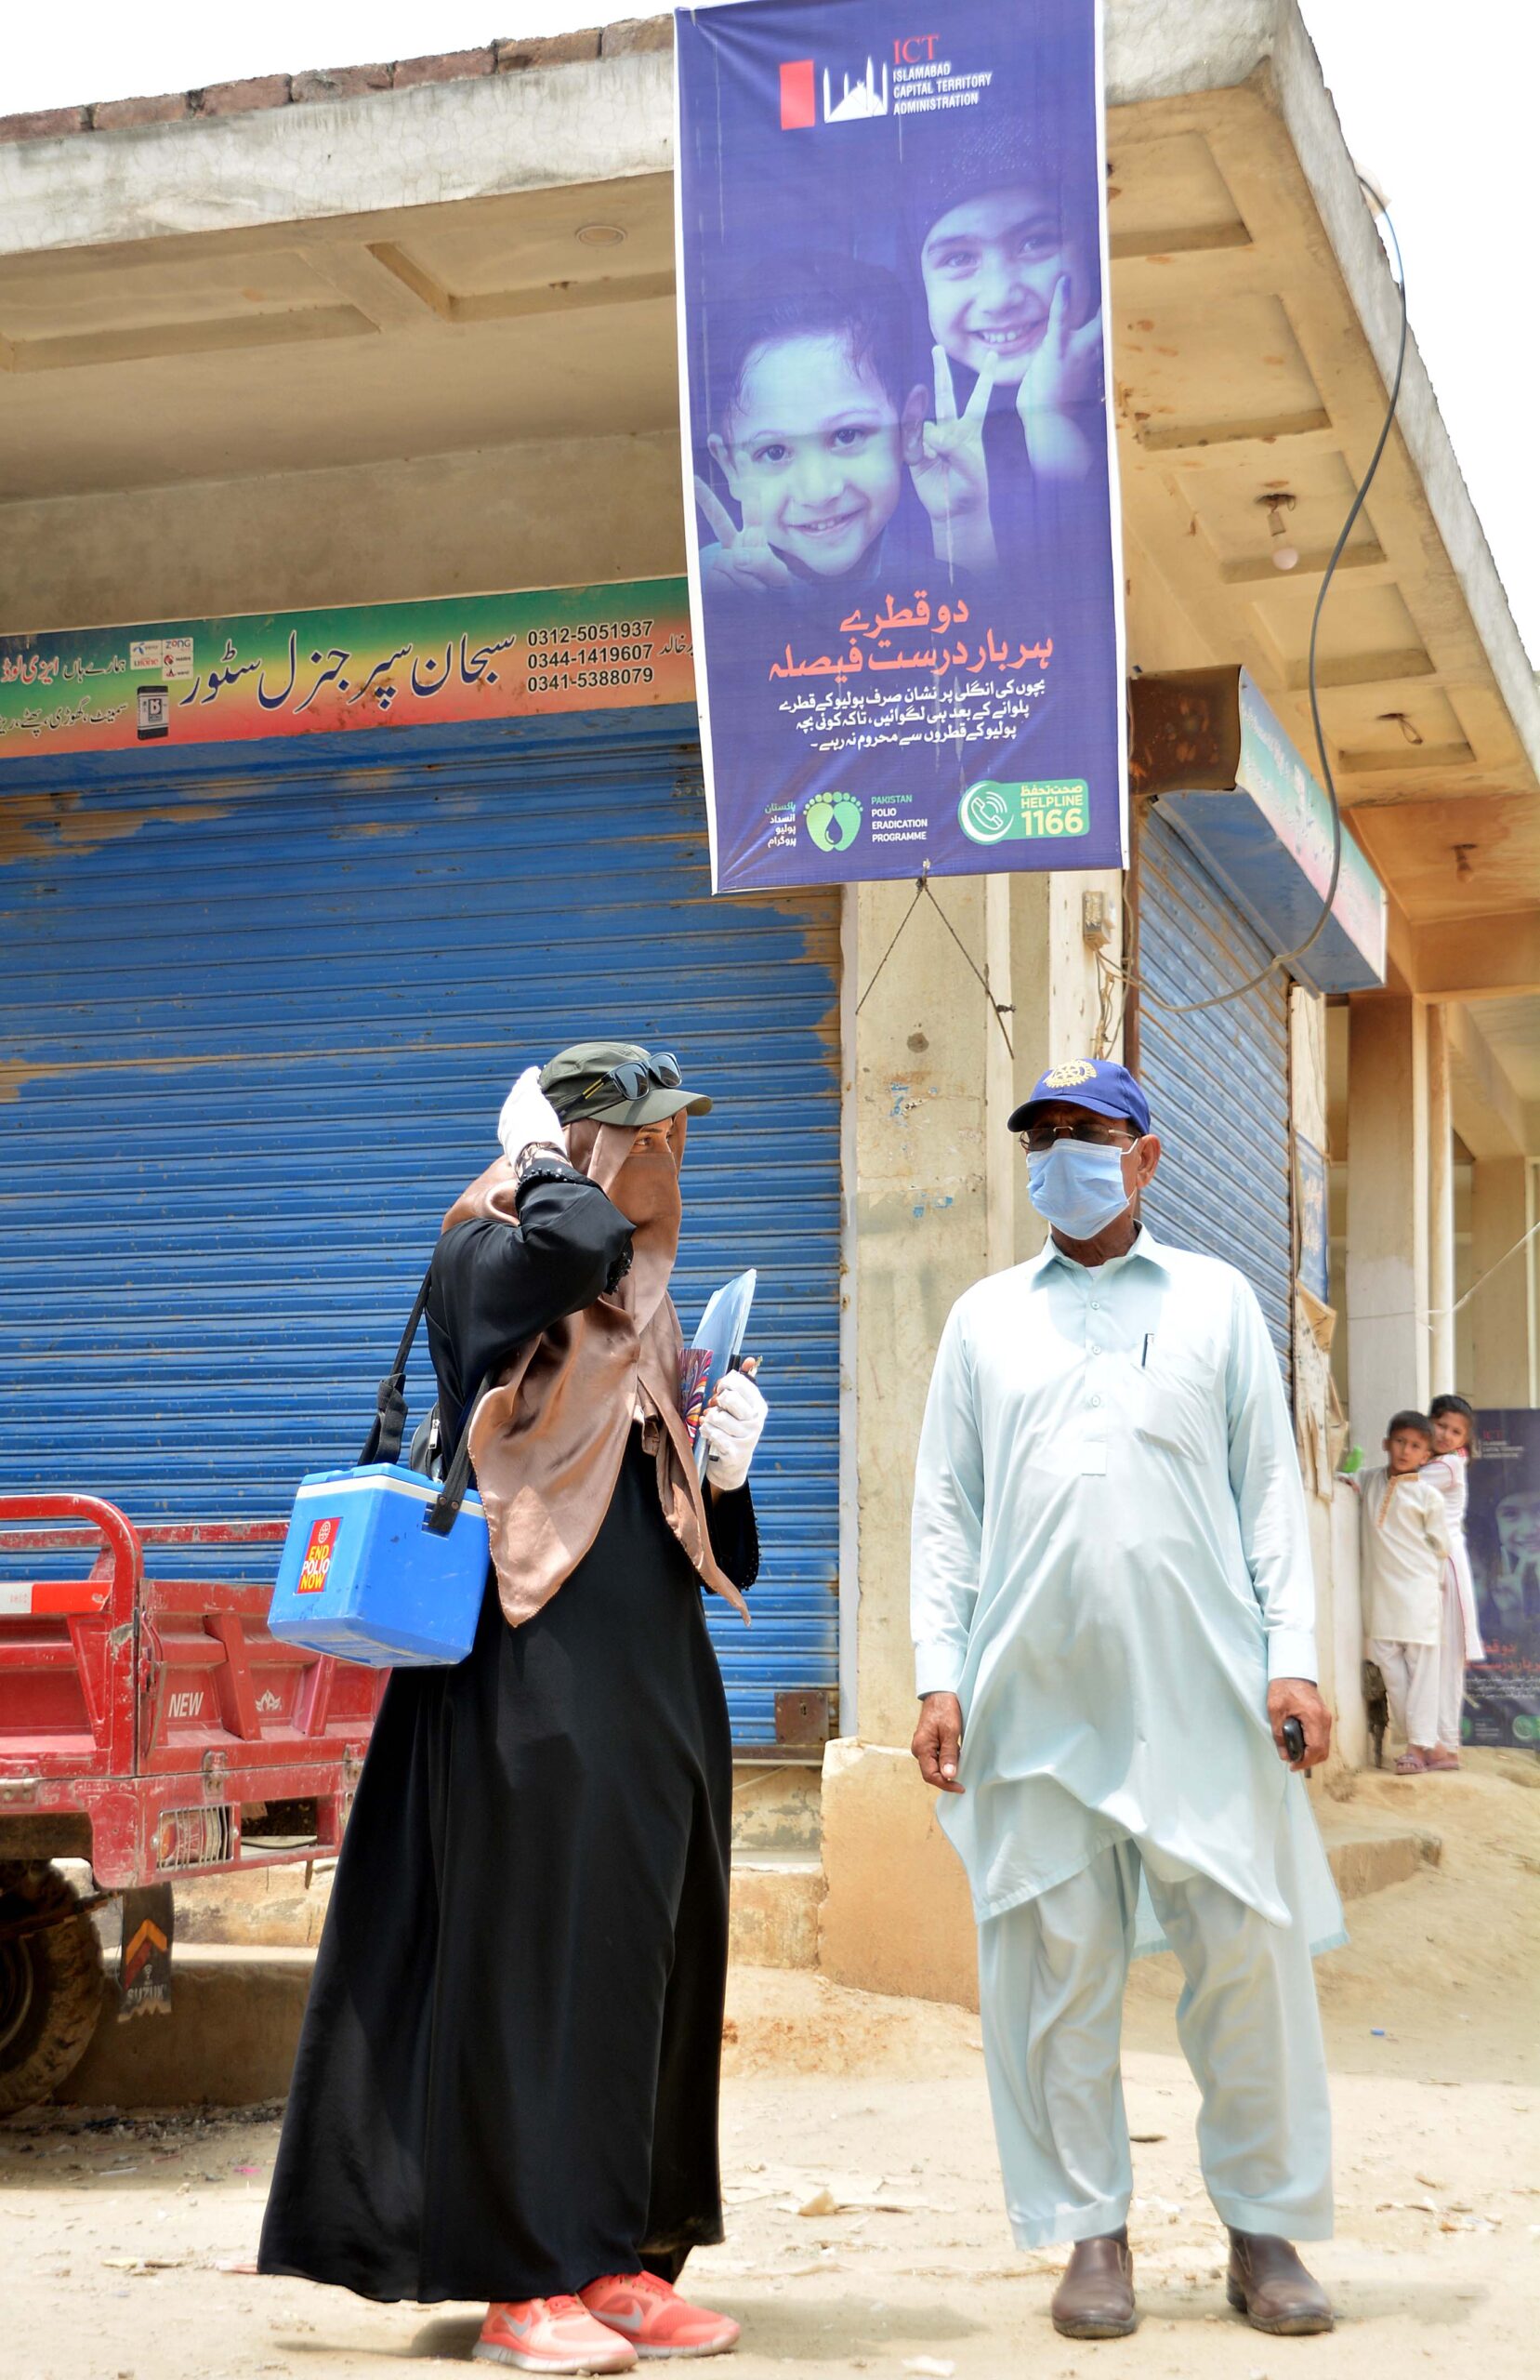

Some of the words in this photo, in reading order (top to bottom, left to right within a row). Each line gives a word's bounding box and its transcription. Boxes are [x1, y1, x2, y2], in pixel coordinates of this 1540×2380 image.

[893, 34, 941, 64] ICT
[893, 60, 951, 82] ISLAMABAD
[893, 81, 933, 99] CAPITAL
[937, 71, 993, 93] TERRITORY
[893, 90, 979, 115] ADMINISTRATION
[839, 589, 930, 640] قطرے
[930, 599, 969, 634] دو
[528, 620, 653, 646] 0312-5051937
[528, 643, 653, 669] 0344-1419607
[769, 637, 863, 683] فیصلہ
[868, 640, 968, 676] درست
[966, 628, 1008, 673] بار
[1007, 637, 1053, 669] ہر
[84, 654, 126, 677] ہمارے
[178, 638, 263, 707] سٹور
[257, 629, 352, 714] جنرل
[411, 632, 517, 698] سبحان
[346, 642, 413, 711] سپر
[528, 667, 653, 693] 0341-5388079
[904, 686, 938, 703] نشان
[940, 689, 953, 704] پر
[954, 681, 994, 702] انگلی
[995, 679, 1015, 698] کی
[1016, 679, 1046, 697] بچوں
[779, 694, 816, 713] قطرے
[815, 692, 834, 711] کے
[833, 691, 864, 709] پولیو
[865, 689, 902, 707] صرف
[927, 711, 947, 724] ہی
[949, 707, 971, 721] بعد
[972, 701, 992, 721] کے
[992, 699, 1030, 719] پلوانے
[796, 716, 814, 734] بچہ
[924, 722, 967, 743] قطروں
[966, 721, 985, 741] کے
[984, 721, 1017, 739] پولیو
[845, 732, 857, 747] نہ
[858, 734, 898, 751] محروم
[899, 733, 922, 746] سے
[765, 801, 796, 813] پاکستان
[871, 795, 913, 805] PAKISTAN
[1020, 794, 1084, 809] HELPLINE
[770, 813, 796, 825] انسداد
[871, 808, 897, 817] POLIO
[1020, 807, 1084, 836] 1166
[775, 825, 796, 836] پولیو
[872, 818, 928, 830] ERADICATION
[768, 836, 796, 848] پروگرام
[872, 831, 927, 842] PROGRAMME
[309, 1544, 330, 1561] END
[301, 1558, 331, 1576] POLIO
[300, 1573, 324, 1590] NOW
[168, 1691, 204, 1718] NEW
